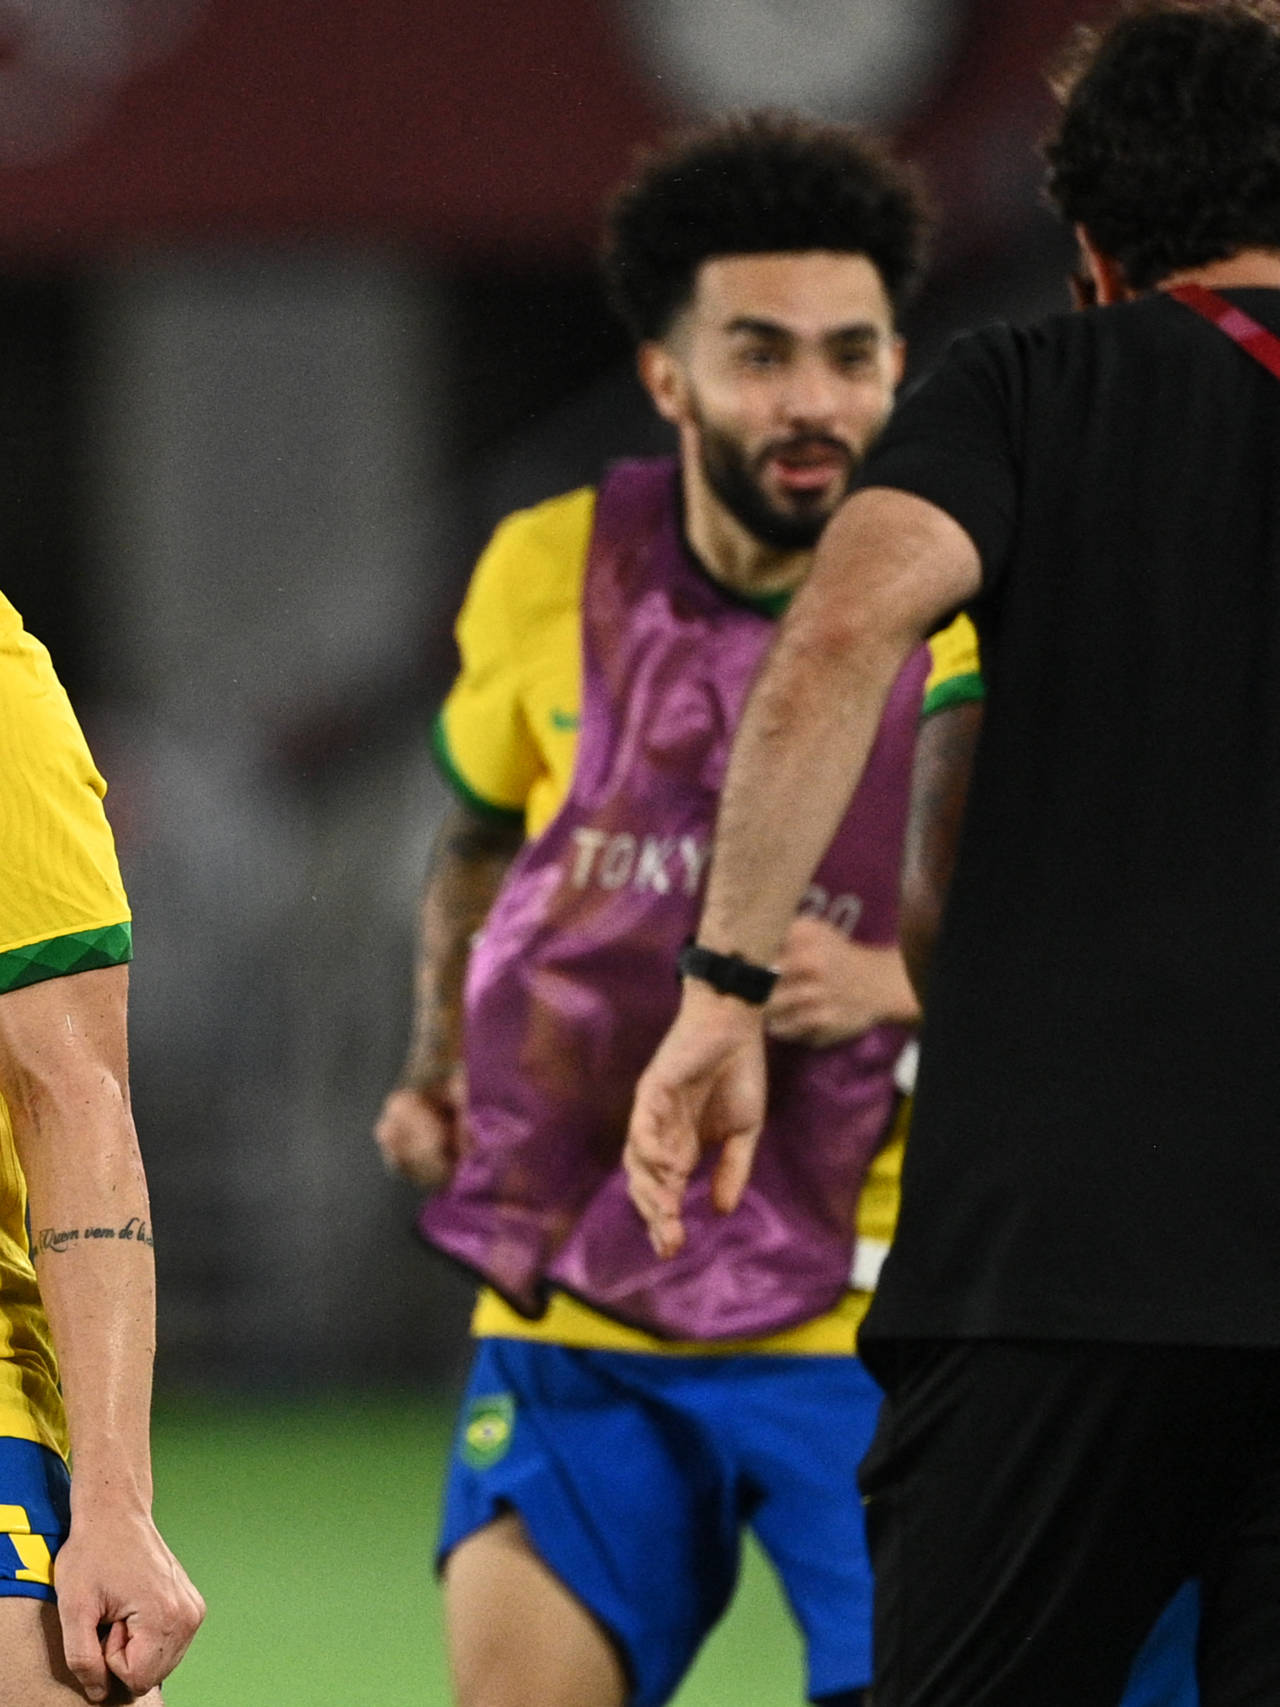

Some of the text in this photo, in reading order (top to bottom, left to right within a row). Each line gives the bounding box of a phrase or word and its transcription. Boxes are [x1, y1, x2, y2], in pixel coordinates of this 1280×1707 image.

[573, 828, 713, 894] TOKY
[84, 1227, 115, 1239] vem
[119, 1217, 140, 1240] de
